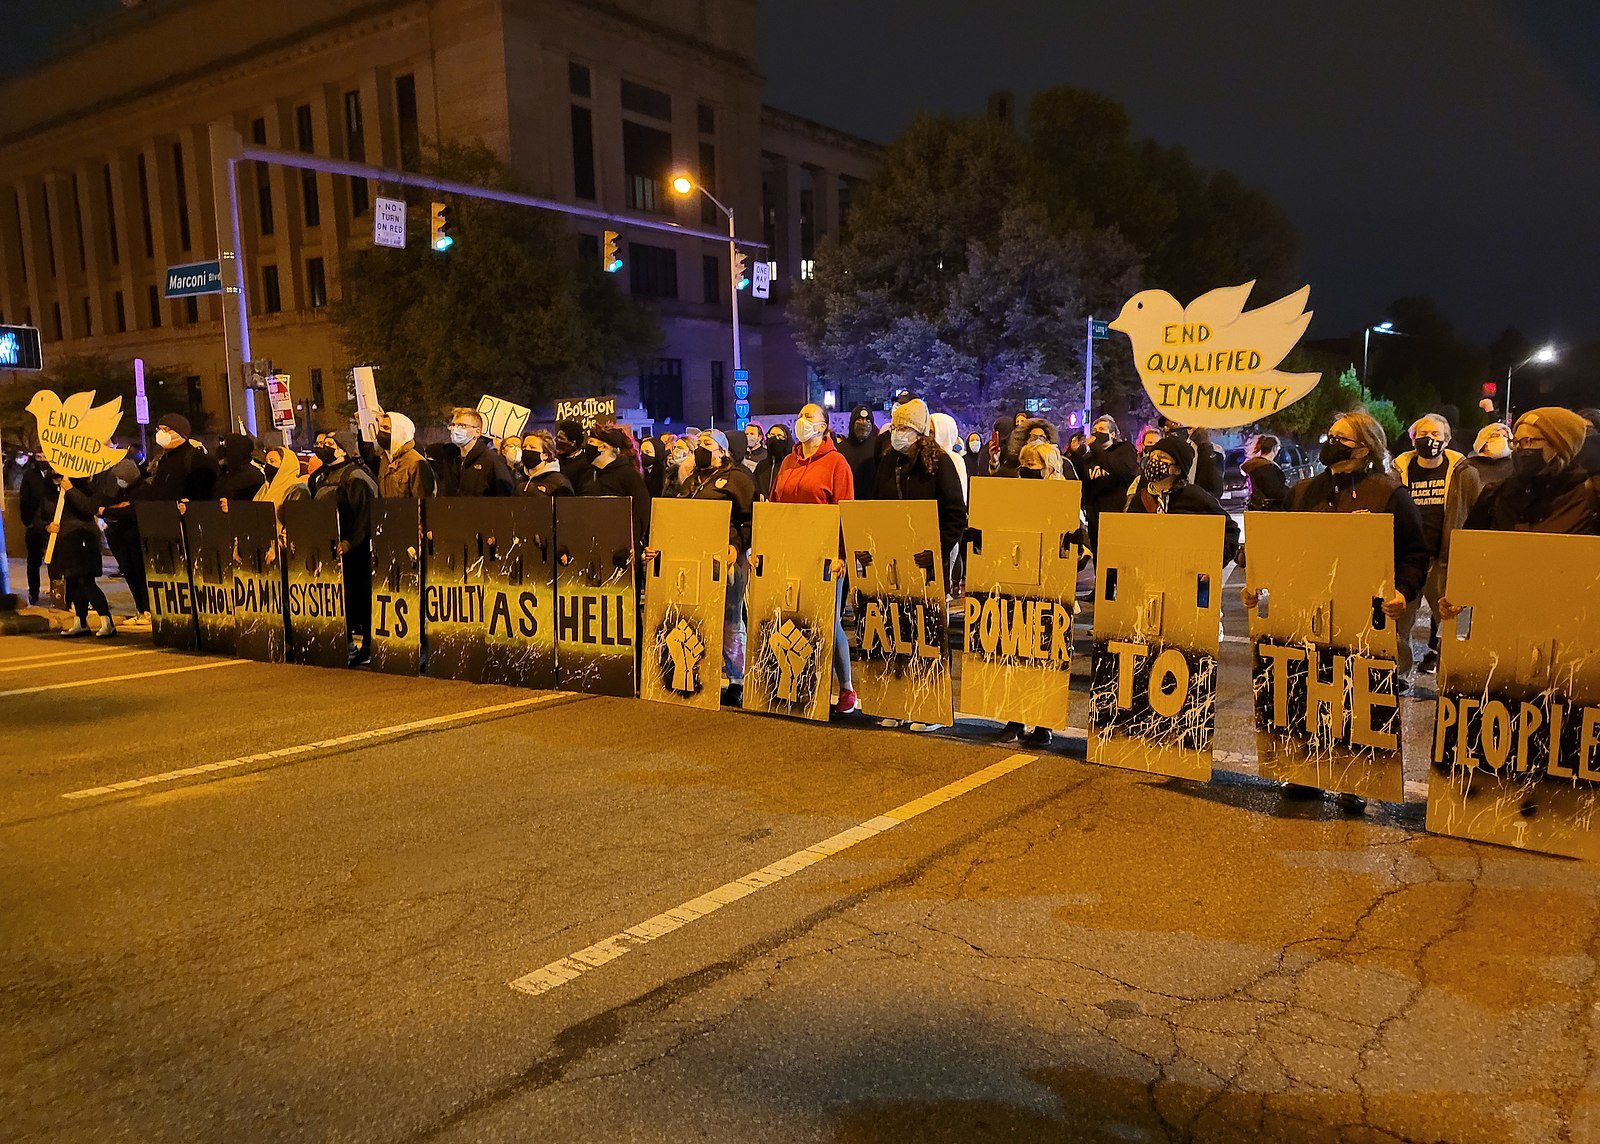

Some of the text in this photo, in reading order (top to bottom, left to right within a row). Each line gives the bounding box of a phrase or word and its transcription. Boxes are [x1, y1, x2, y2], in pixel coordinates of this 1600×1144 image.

[385, 203, 397, 211] NO
[382, 213, 400, 222] TURN
[377, 222, 387, 231] ON
[390, 225, 403, 234] RED
[757, 266, 767, 274] ONE
[169, 271, 206, 290] Marconi
[1164, 325, 1210, 343] END
[1147, 350, 1261, 373] QUALIFIED
[737, 386, 747, 395] 70
[1158, 383, 1287, 410] IMMUNITY
[478, 397, 528, 438] BLM
[556, 398, 614, 421] ABOLITION
[739, 406, 747, 414] 71
[49, 410, 79, 429] END
[41, 428, 101, 454] QUALIFIED
[49, 447, 111, 475] IMMUNITY
[1411, 479, 1445, 489] YOUR FEAR
[1411, 489, 1431, 497] BLACK
[148, 577, 632, 646] THE WHOL DAMN SYSTEM IS GUILTY AS HELL
[862, 596, 1600, 781] ALL POWER TO THE PEOPLE
